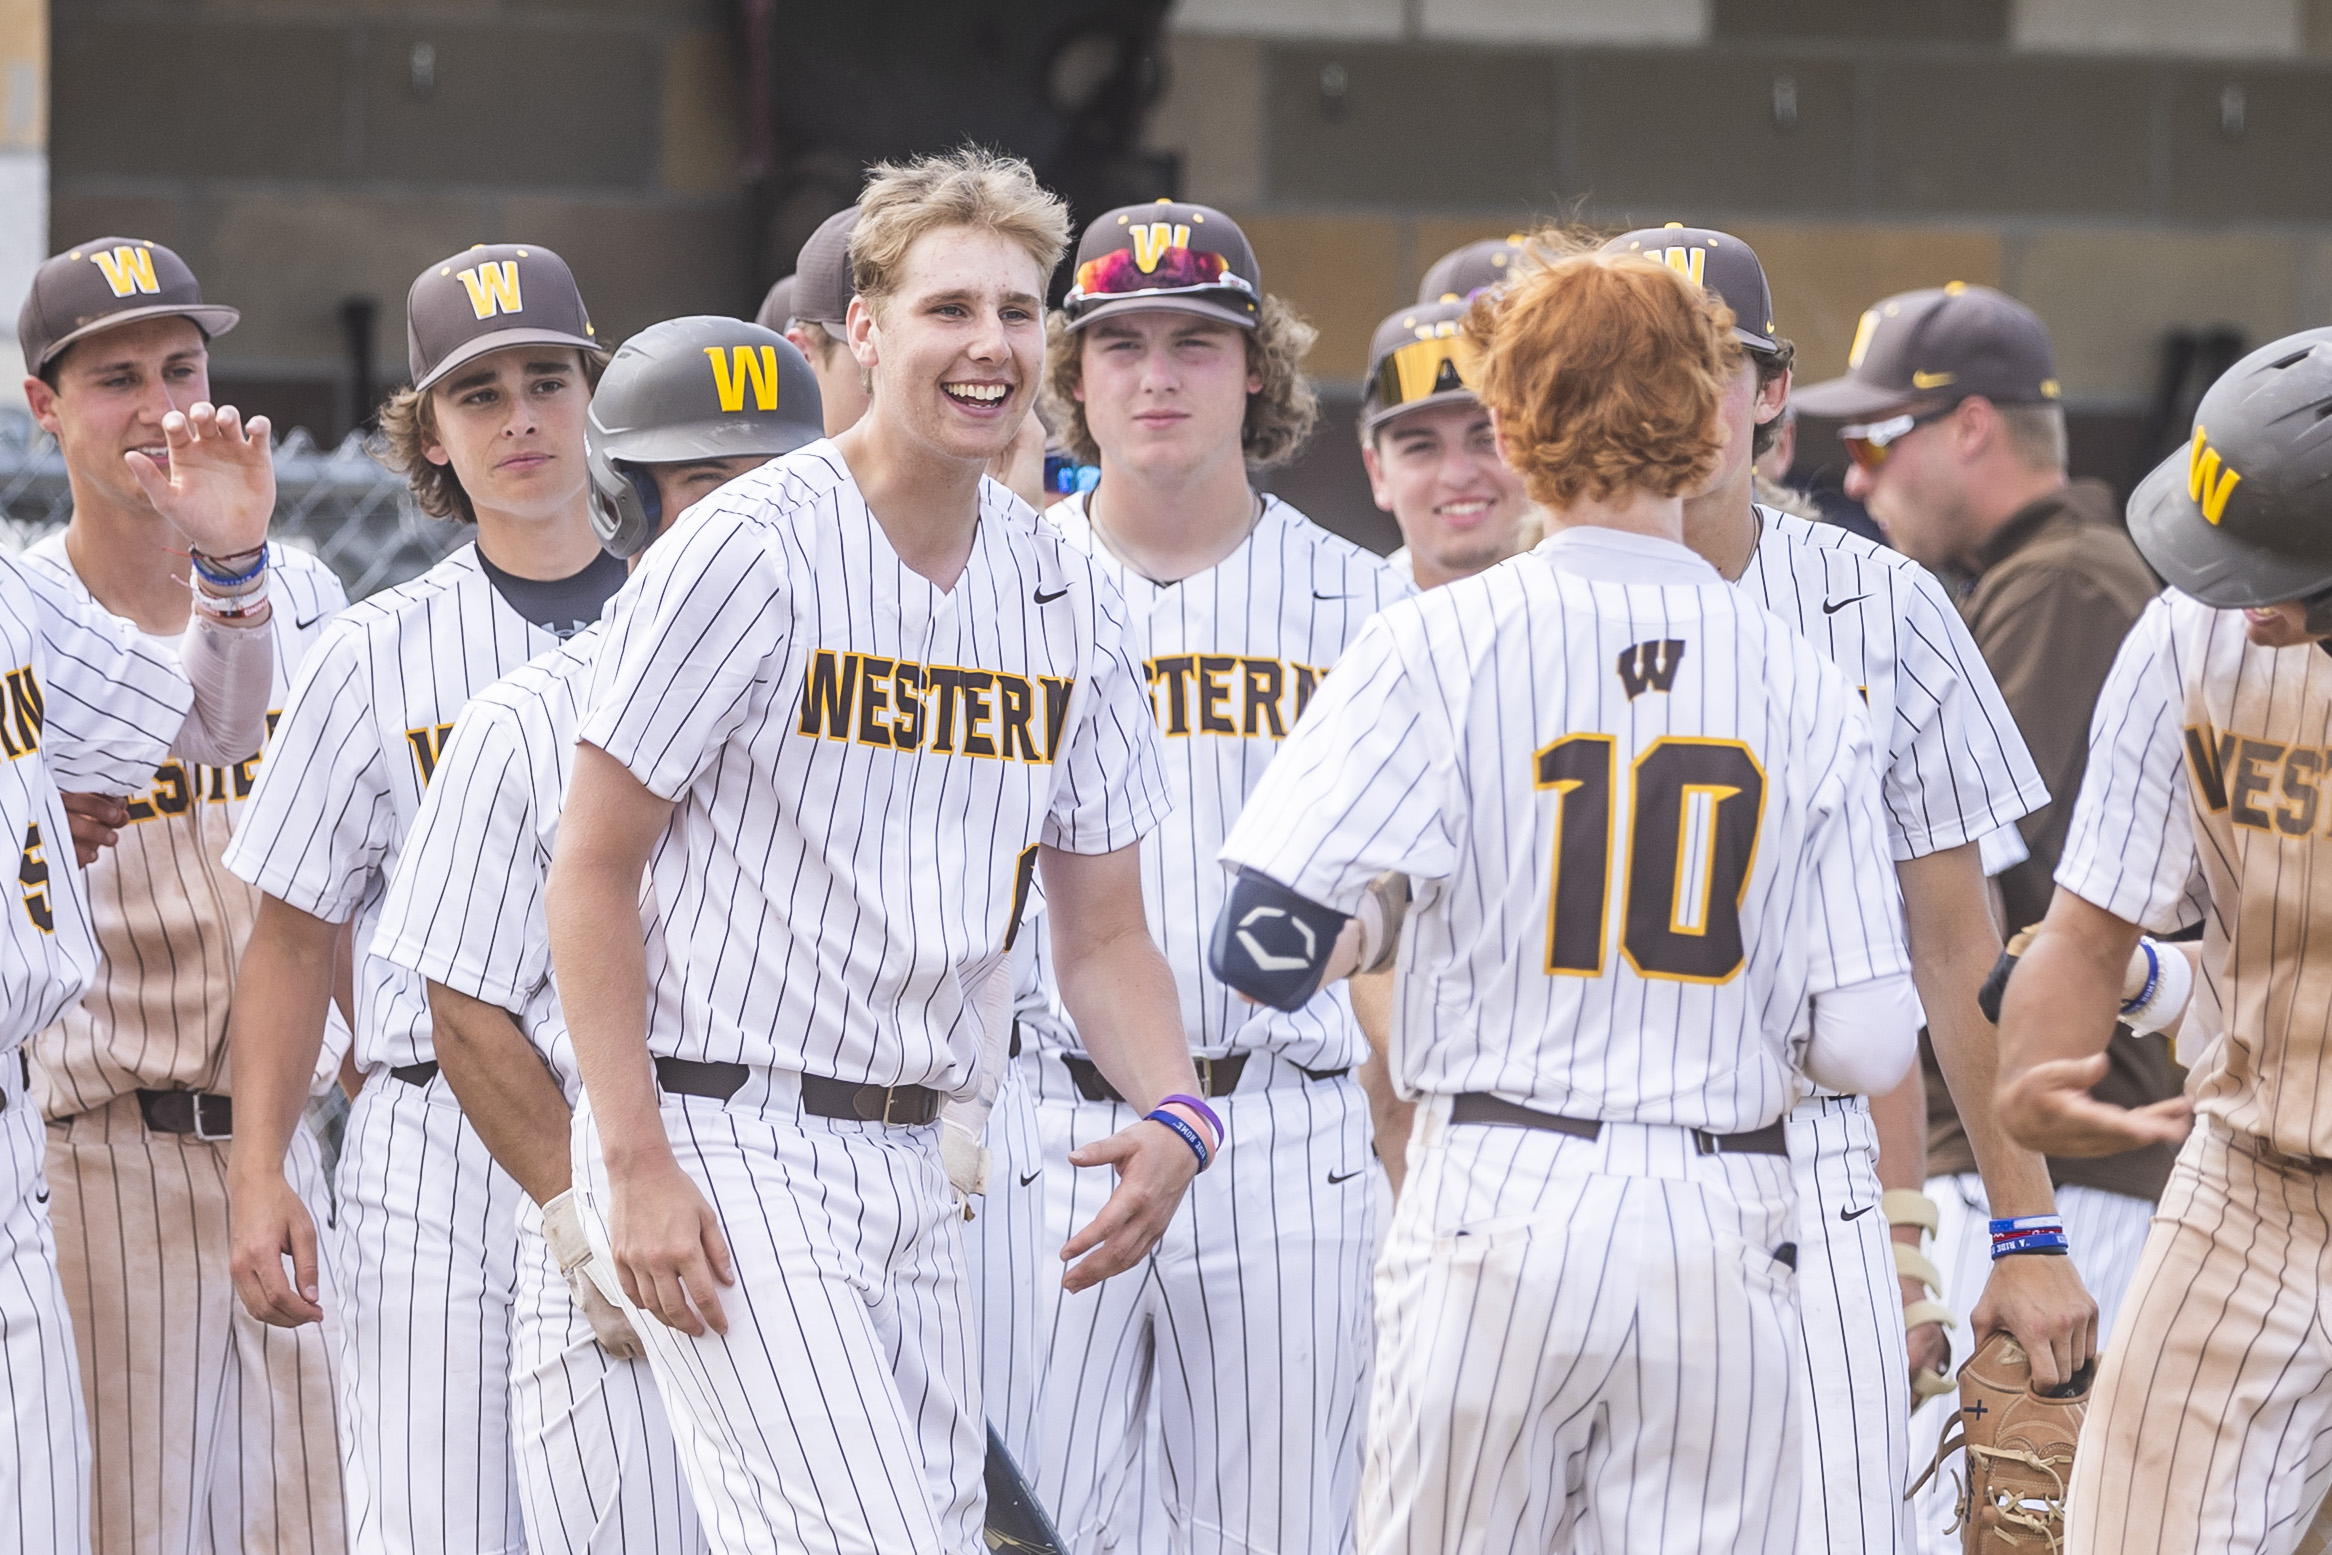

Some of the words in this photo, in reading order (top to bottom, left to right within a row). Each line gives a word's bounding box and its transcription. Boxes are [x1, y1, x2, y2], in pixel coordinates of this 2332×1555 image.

[89, 245, 161, 298] W
[1129, 222, 1191, 274] W
[456, 260, 523, 320] W
[703, 345, 778, 412] W
[2187, 424, 2241, 526] W
[1617, 639, 1686, 703] W
[2183, 721, 2332, 842] WES
[1531, 731, 1768, 986] 10
